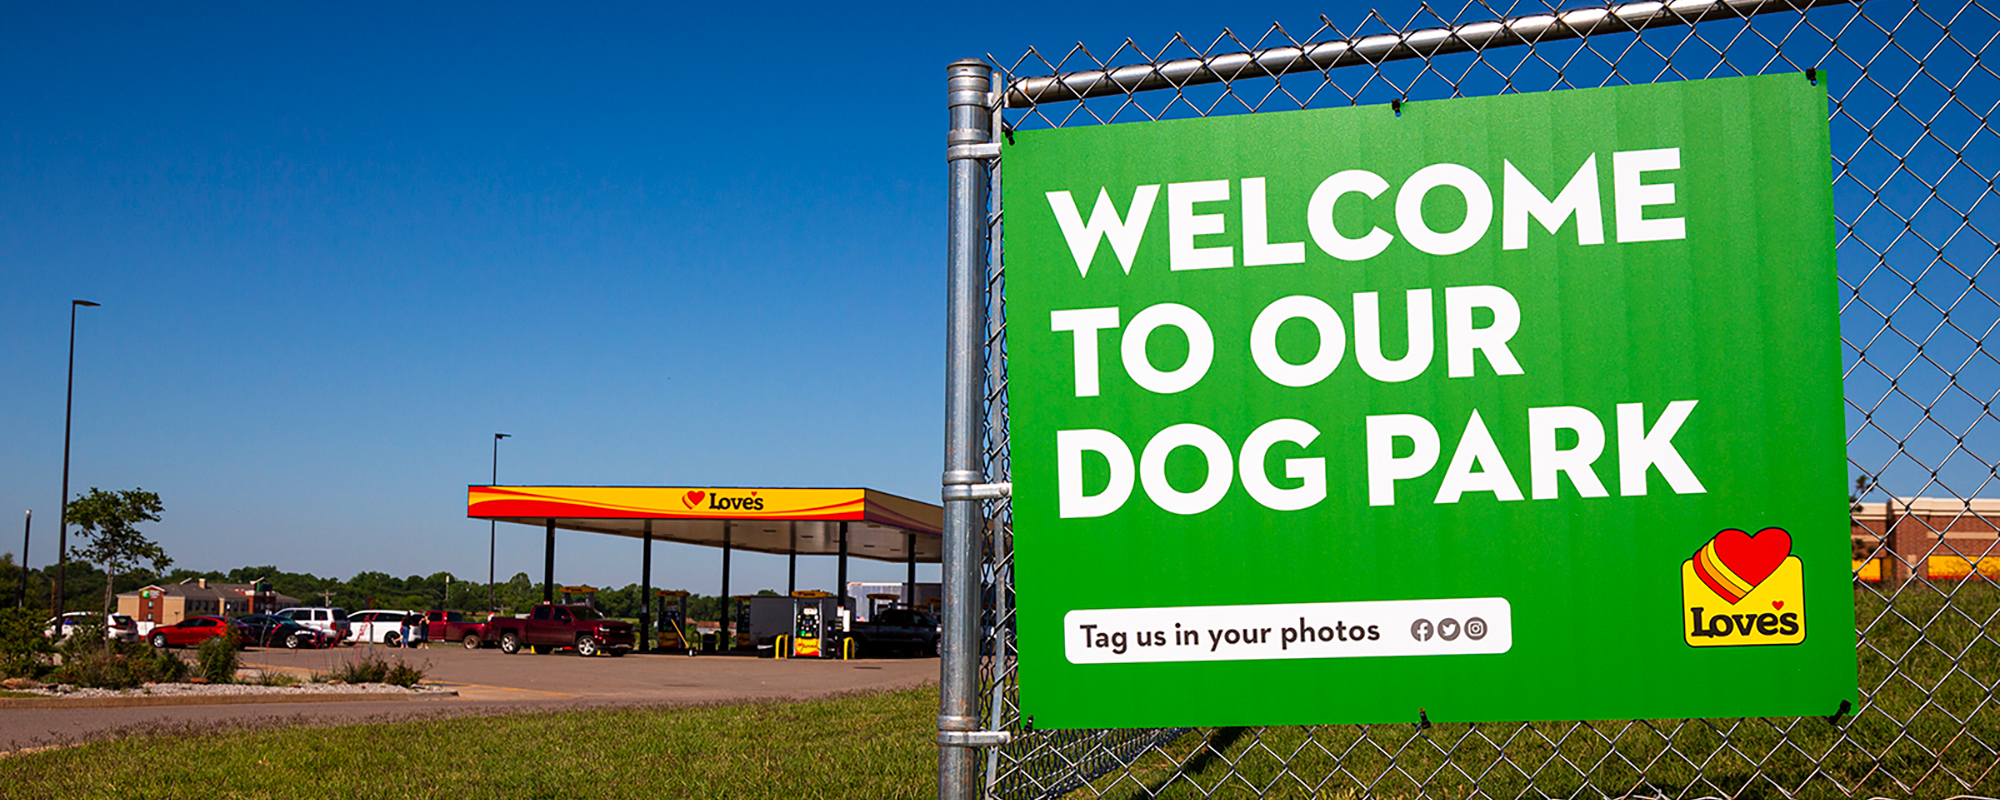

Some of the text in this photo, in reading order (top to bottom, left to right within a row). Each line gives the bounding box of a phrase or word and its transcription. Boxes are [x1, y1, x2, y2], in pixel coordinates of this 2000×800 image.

[1045, 147, 1687, 279] WELCOME
[1050, 284, 1525, 398] TO OUR
[1056, 399, 1708, 519] DOG PARK
[1079, 616, 1381, 655] Tag us in your photos
